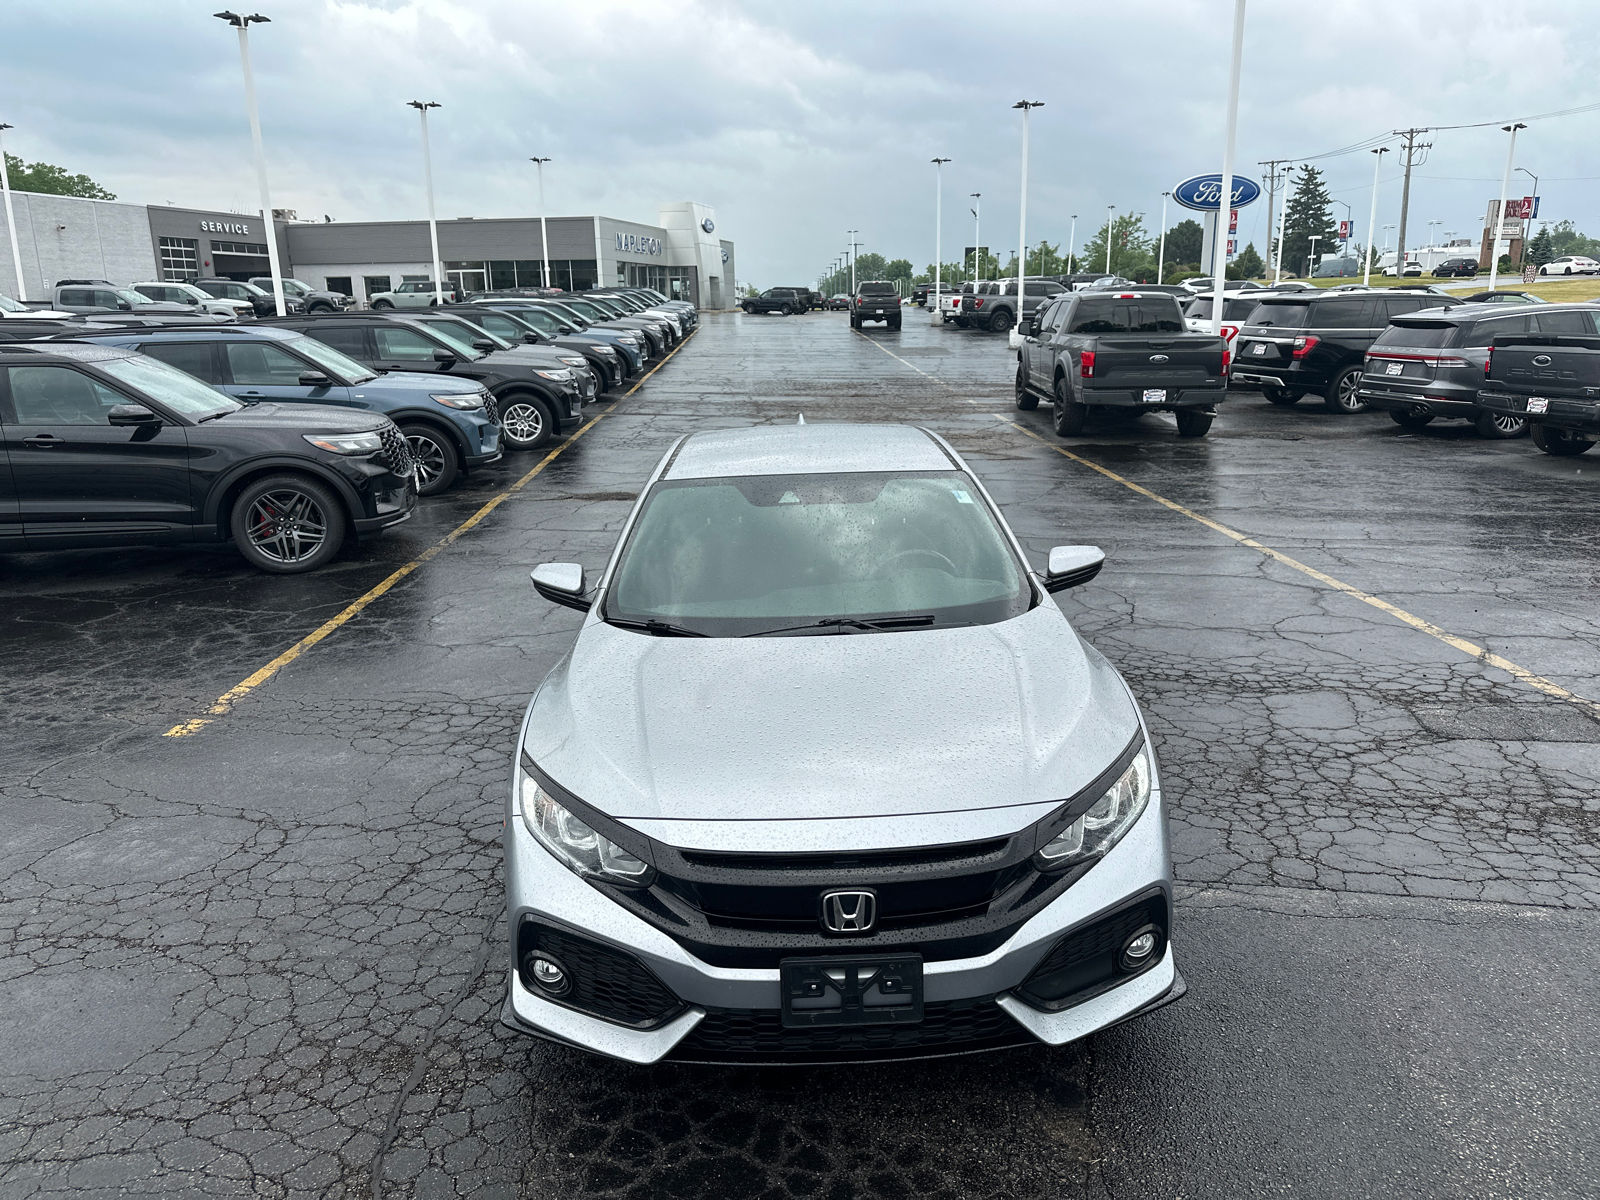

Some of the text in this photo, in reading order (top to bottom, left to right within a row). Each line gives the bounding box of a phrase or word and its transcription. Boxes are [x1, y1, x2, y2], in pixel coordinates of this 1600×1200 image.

[1193, 181, 1244, 202] Fod
[201, 220, 249, 235] SERVICE
[615, 232, 662, 255] NAPLETON
